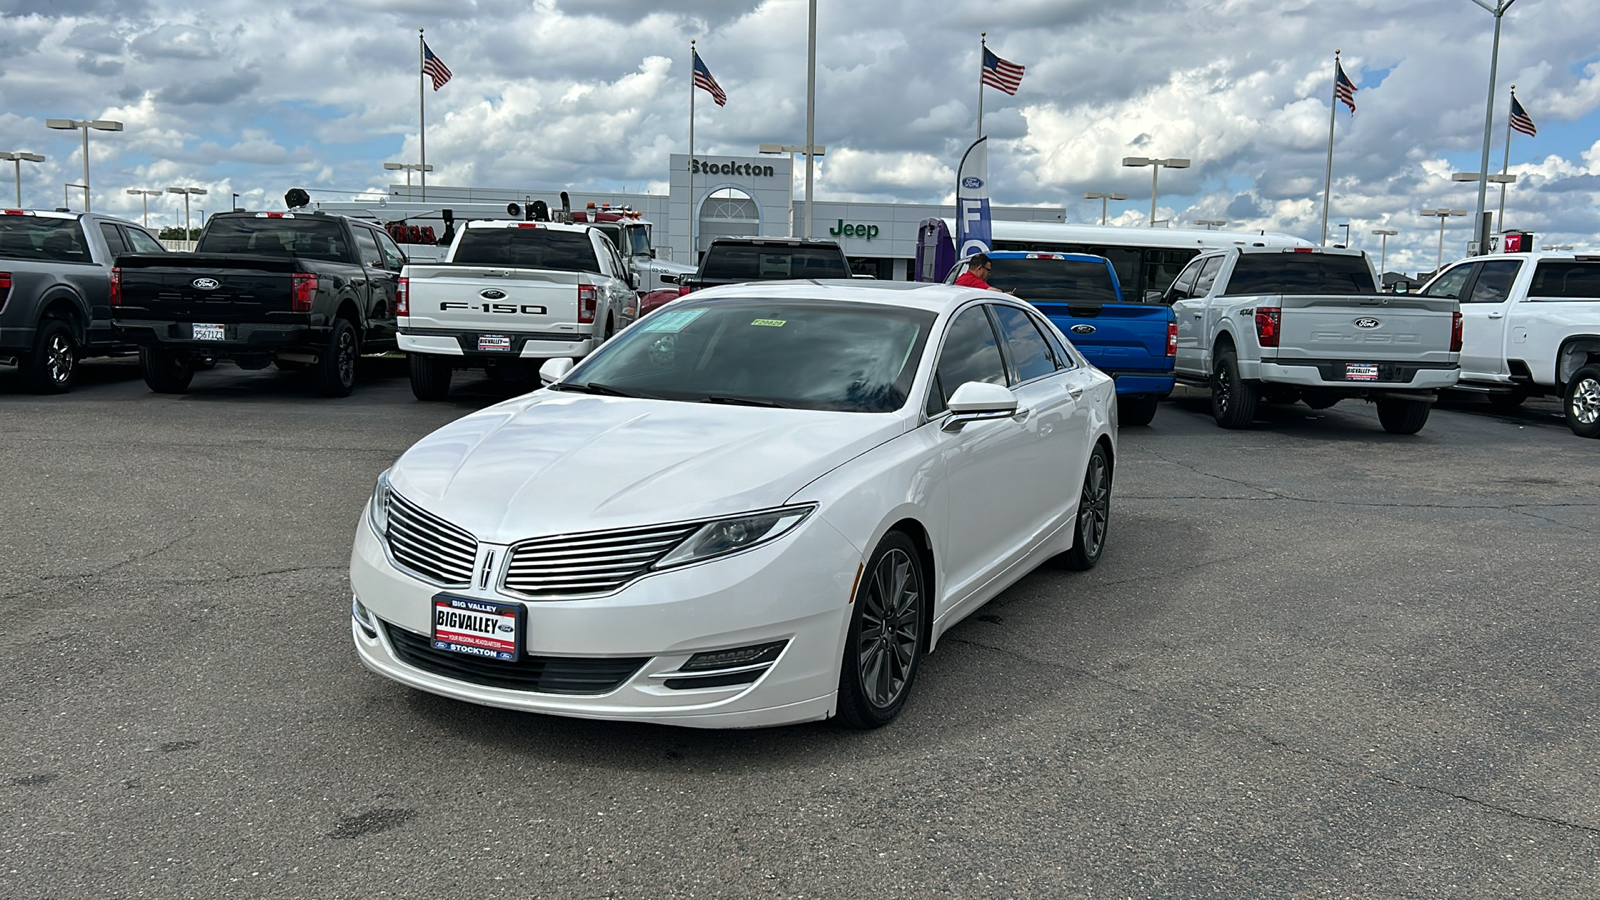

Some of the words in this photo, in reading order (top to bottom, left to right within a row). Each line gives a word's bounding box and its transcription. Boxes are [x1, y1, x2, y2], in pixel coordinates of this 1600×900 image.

[688, 159, 774, 177] Stockton
[963, 178, 983, 188] Ford
[829, 219, 879, 244] Jeep
[440, 302, 547, 315] F-150
[1310, 331, 1421, 344] F-150
[451, 600, 466, 608] BIG
[467, 602, 497, 612] VALLEY
[437, 610, 499, 634] BIGVALLEY
[450, 644, 497, 657] STOCKTON
